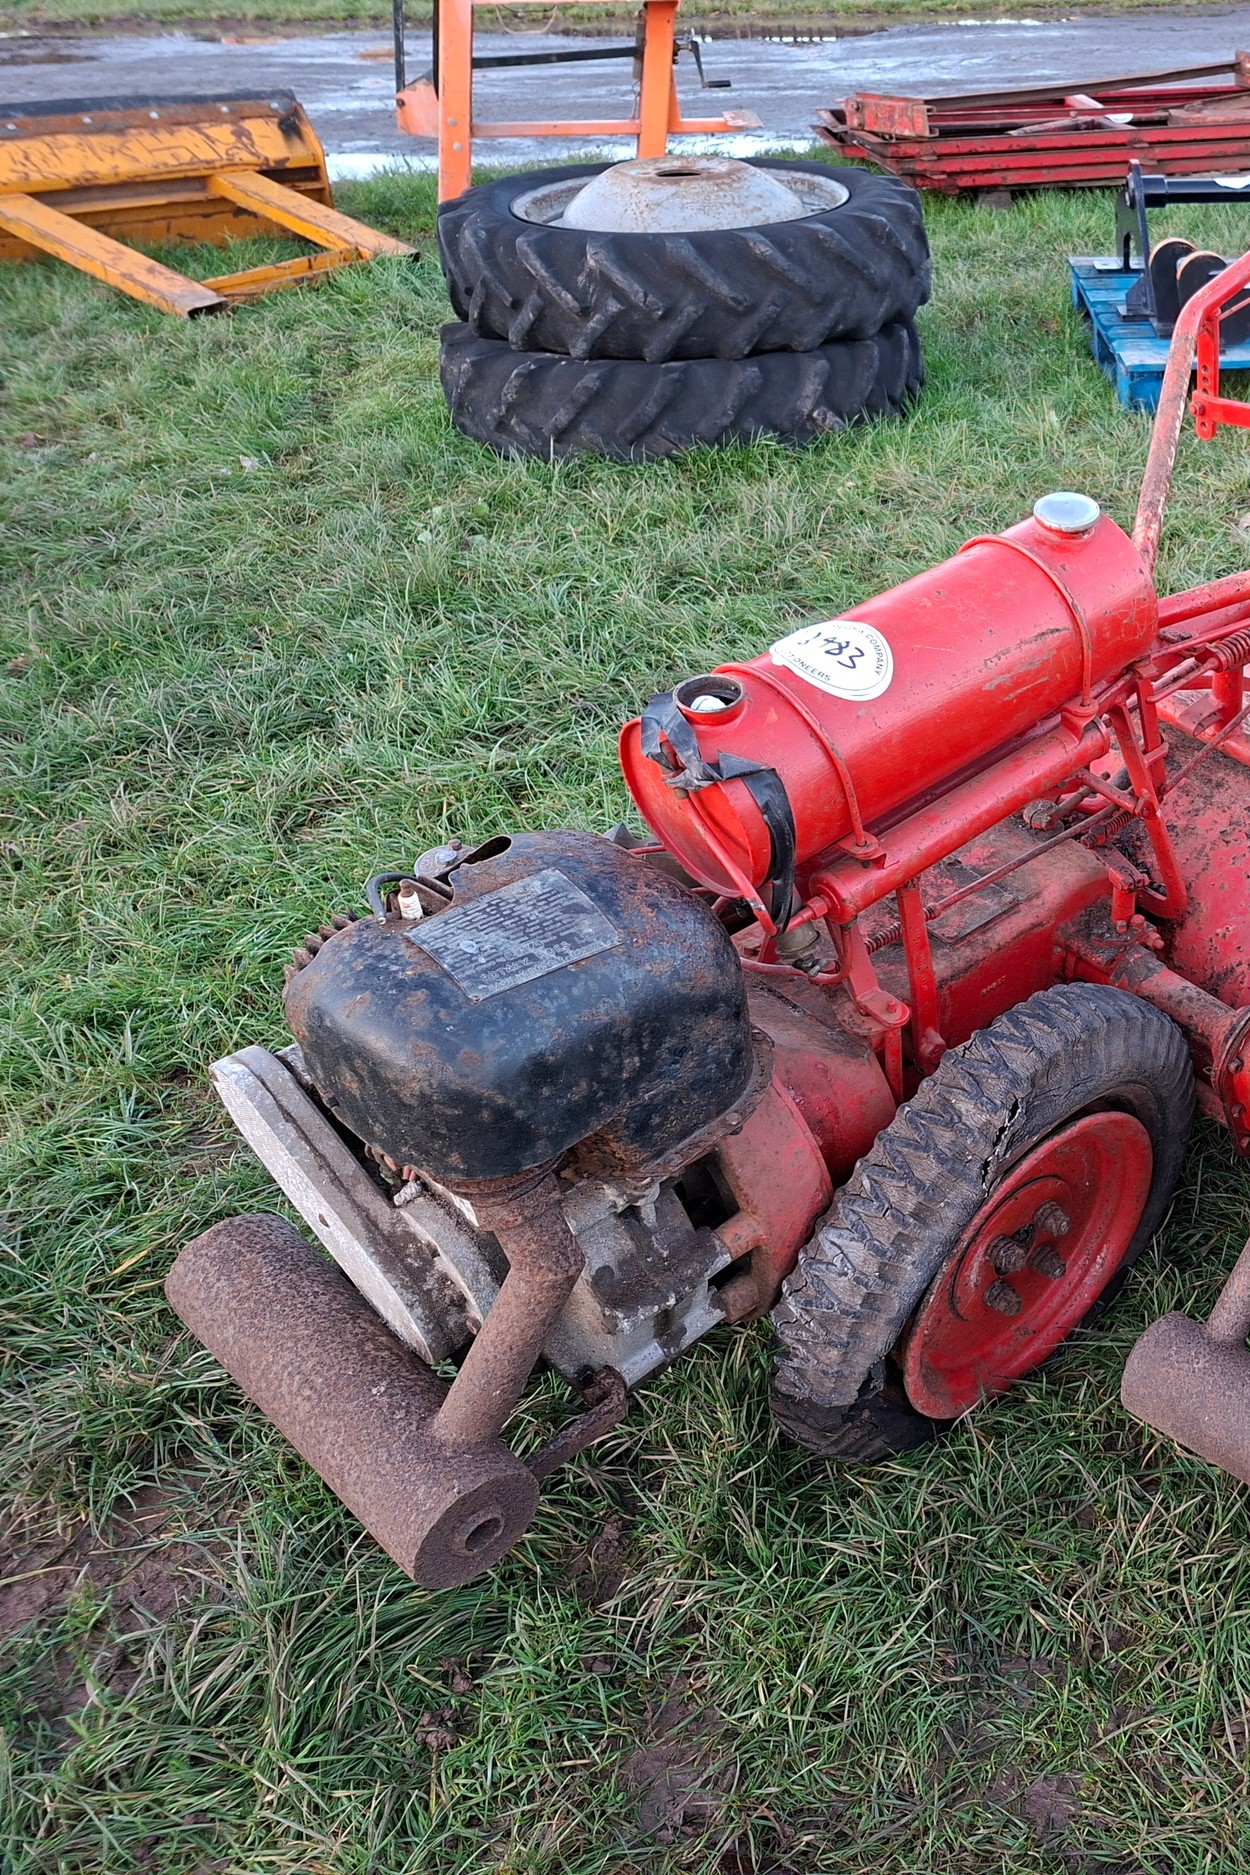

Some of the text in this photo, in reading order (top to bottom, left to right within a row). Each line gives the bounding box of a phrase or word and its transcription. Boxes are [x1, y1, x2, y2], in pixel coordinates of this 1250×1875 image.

[865, 634, 885, 676] COMPANY
[479, 956, 530, 983] ROTARY
[535, 939, 571, 960] HOES
